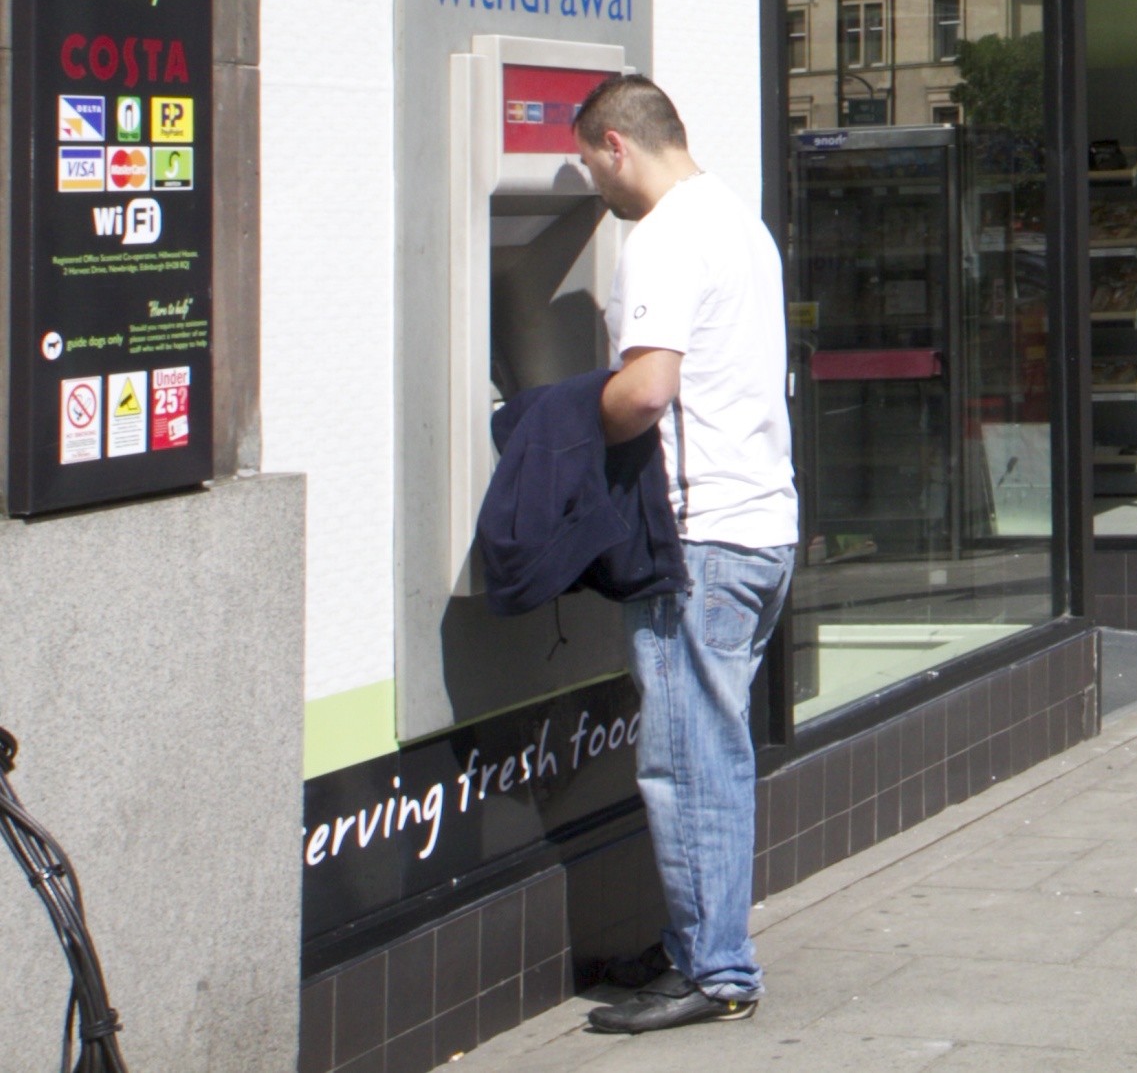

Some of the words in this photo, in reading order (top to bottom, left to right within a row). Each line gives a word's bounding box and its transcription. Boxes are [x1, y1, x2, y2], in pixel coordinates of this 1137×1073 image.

[60, 33, 189, 88] COSTA
[76, 105, 103, 114] DELTA
[67, 161, 96, 178] VISA
[66, 338, 87, 351] guide
[89, 335, 105, 349] dogs
[107, 333, 123, 346] only
[155, 372, 187, 386] Under
[302, 776, 443, 865] erving
[458, 719, 557, 812] fresh
